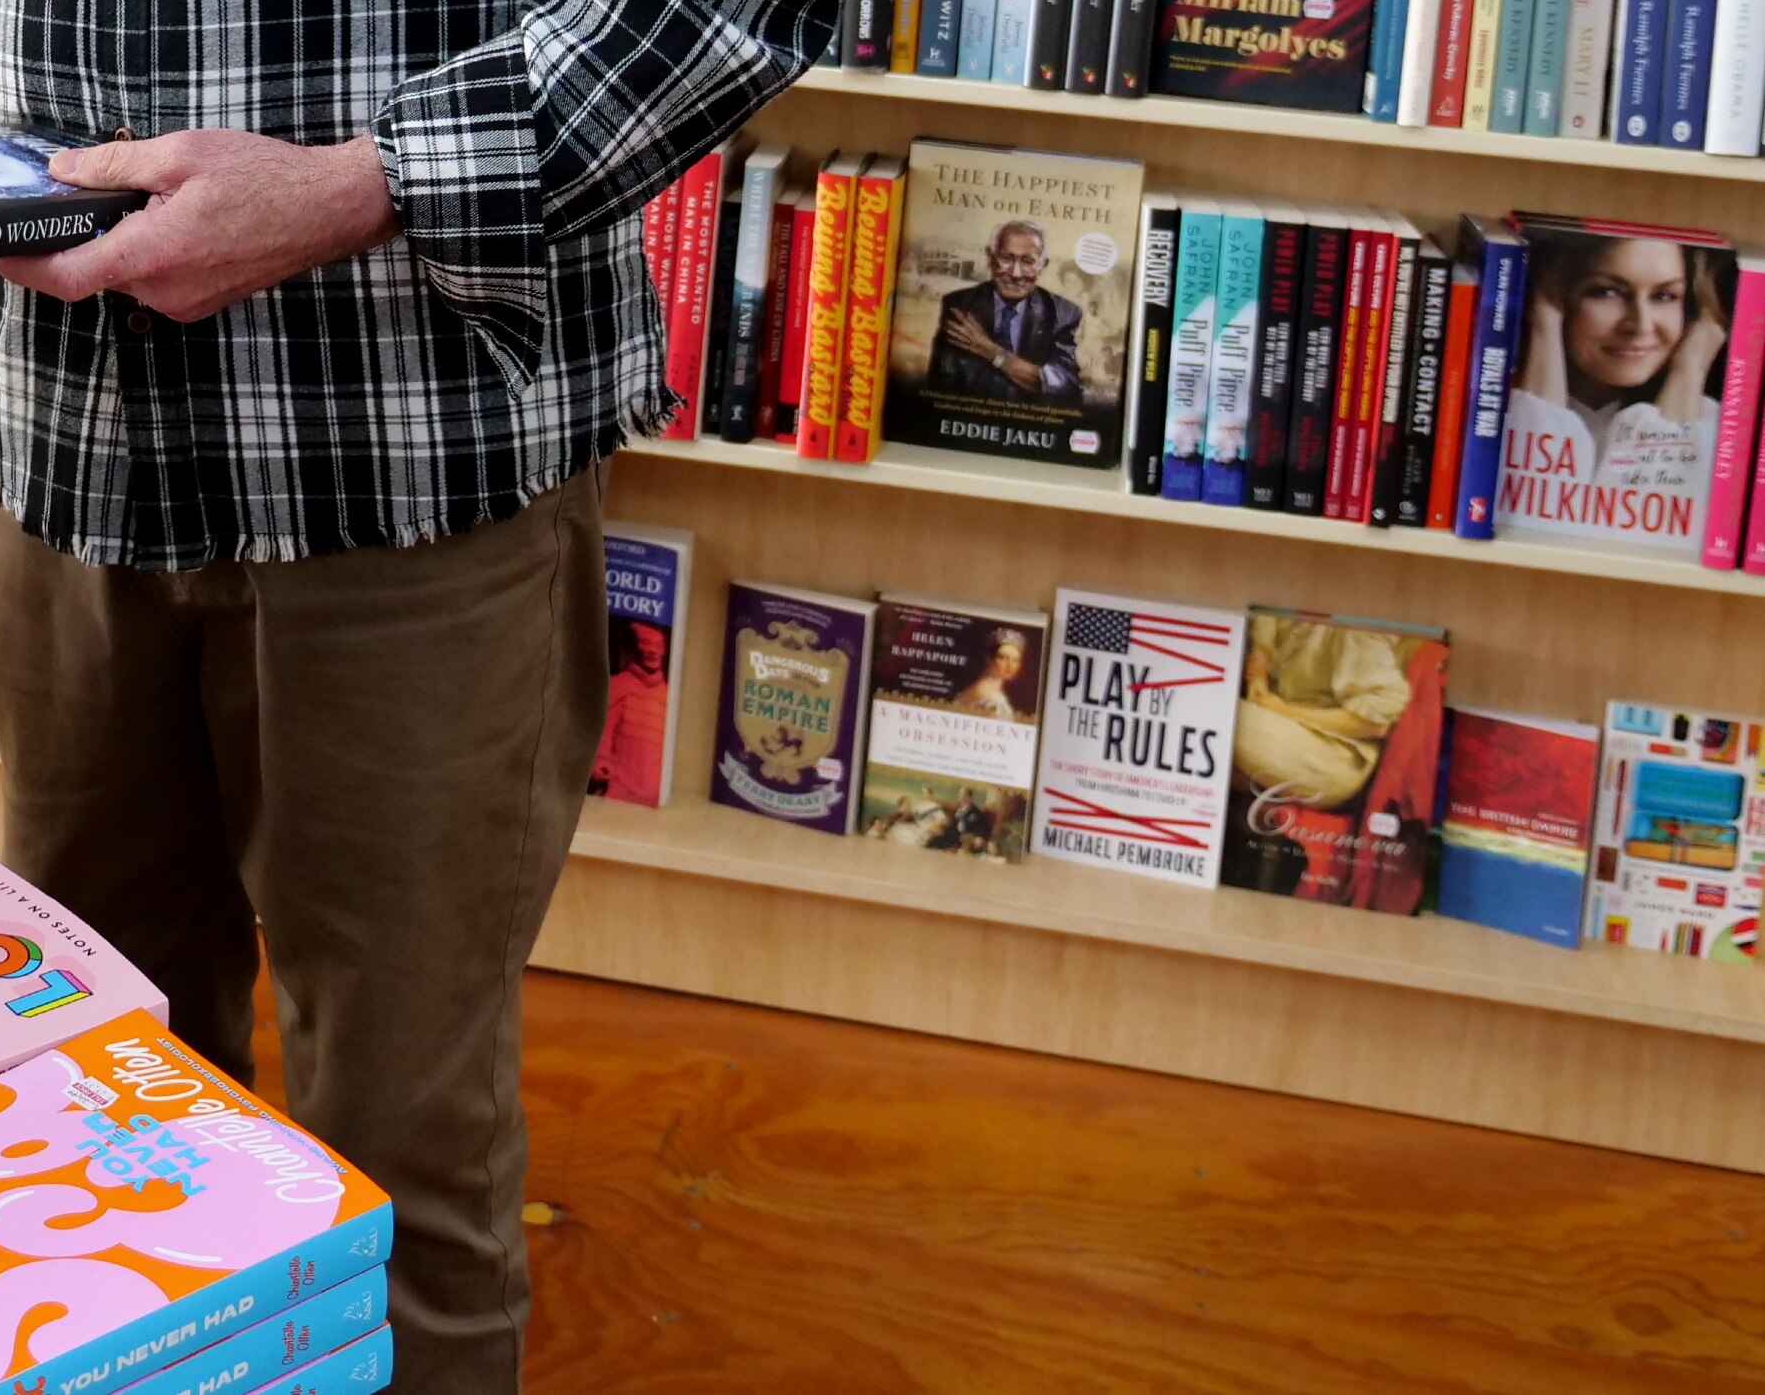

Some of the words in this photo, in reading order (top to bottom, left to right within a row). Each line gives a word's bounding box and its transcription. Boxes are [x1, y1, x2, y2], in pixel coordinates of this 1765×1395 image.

[1172, 14, 1348, 62] Margolyes
[933, 186, 986, 211] MAN
[994, 199, 1020, 214] on
[1029, 199, 1112, 224] EARTH
[934, 163, 984, 186] THE
[992, 167, 1116, 201] HAPPIEST
[6, 212, 95, 244] WONDERS
[1141, 229, 1173, 308] RECOVERY
[938, 419, 1000, 441] EDDIE
[1004, 426, 1057, 450] JAKU
[1504, 429, 1577, 477] LISA
[1500, 477, 1694, 537] WILKINSON
[890, 643, 969, 667] RAPPAPORT
[911, 630, 956, 648] HELEN
[744, 680, 832, 714] ROMAN
[1059, 652, 1151, 713] PLAY
[1149, 685, 1175, 715] BY
[743, 699, 830, 735] EMPIRE
[1067, 706, 1102, 741] THE
[1104, 712, 1219, 780] RULES
[1042, 825, 1113, 862] MICHAEL
[1117, 836, 1207, 879] PEMBROKE
[54, 916, 98, 957] NOTES
[104, 1036, 205, 1104] Otten
[175, 1095, 347, 1204] Chantelle
[59, 1362, 116, 1395] YOU
[116, 1318, 200, 1380] NEVER
[203, 1294, 256, 1333] HAD
